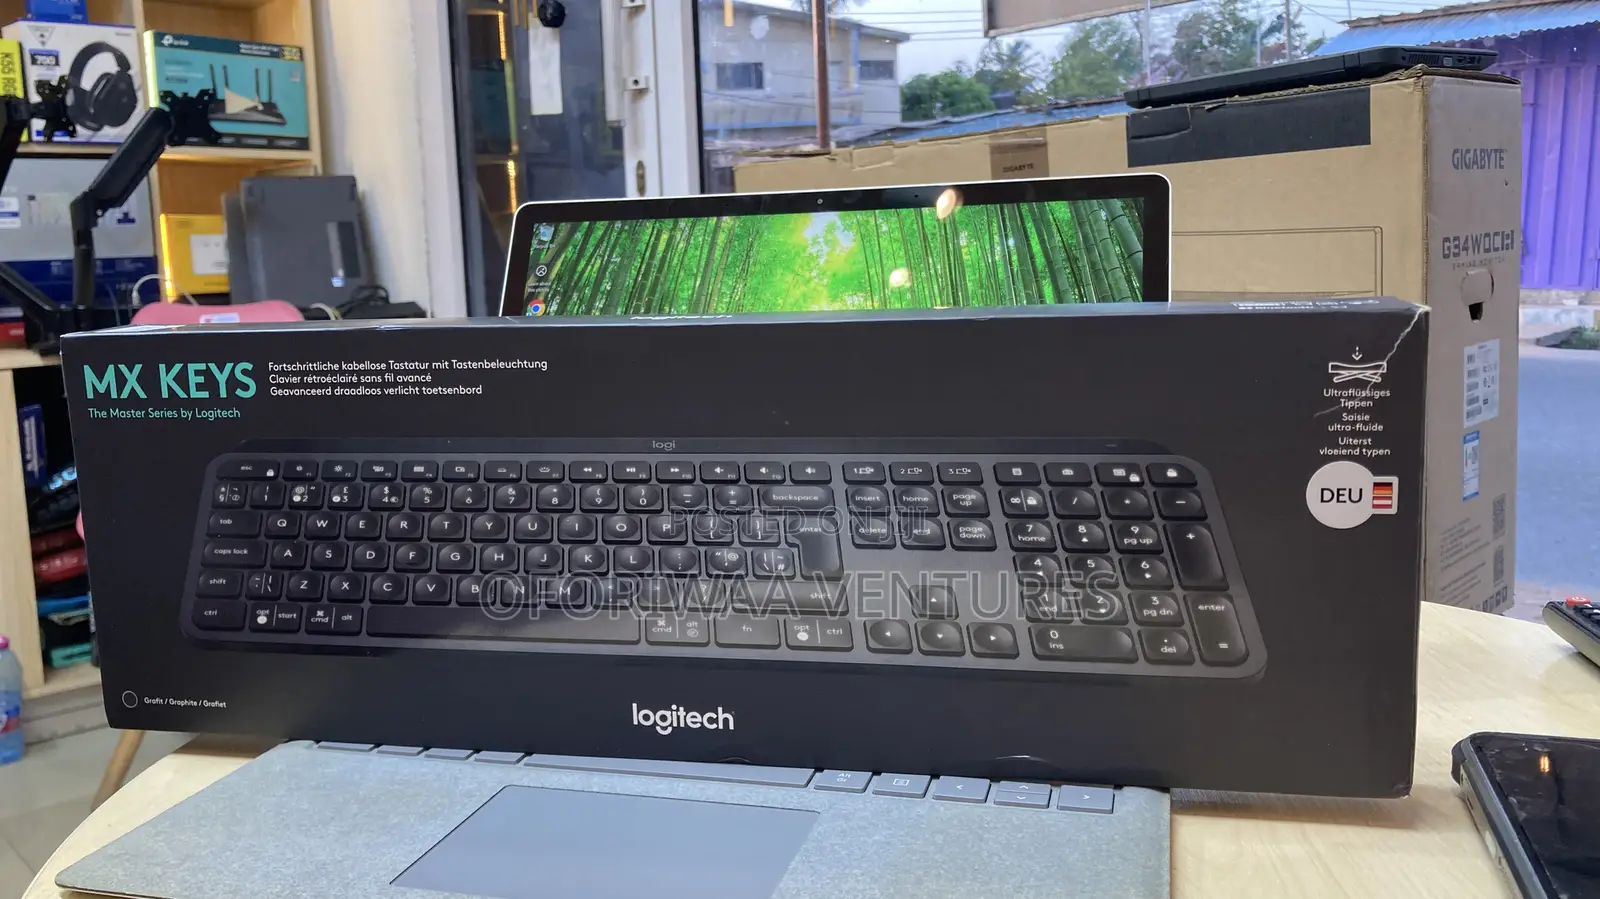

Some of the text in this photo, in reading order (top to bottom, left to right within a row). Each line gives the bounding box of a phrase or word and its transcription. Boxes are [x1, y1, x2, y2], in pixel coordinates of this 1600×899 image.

[1452, 148, 1505, 170] GIGABYTE
[1002, 163, 1034, 173] GIGABYTE
[268, 359, 548, 371] Fortschrittliche kabellose Tastatur mit Tastenbeleuchtung
[83, 361, 257, 399] MX KEYS
[269, 372, 432, 384] Clavier rétroéclairé sans fil avancé
[270, 385, 483, 396] Geavanceerd draadloos verlicht toetsenbord
[1323, 388, 1391, 399] Ultraflüssiges
[1340, 399, 1373, 409] Tippen
[88, 407, 241, 421] The Master Series by Logitech
[1342, 412, 1370, 421] Saisie
[1328, 422, 1384, 432] ultra-fluide
[1338, 436, 1372, 445] Uiterst
[652, 440, 676, 451] logi
[1319, 447, 1391, 458] vloeiend typen
[342, 495, 348, 503] 3
[772, 494, 819, 502] backspace
[855, 494, 881, 502] insert
[1320, 488, 1363, 503] DEU
[552, 497, 559, 505] 8
[277, 519, 288, 528] Q
[316, 520, 328, 528] W
[359, 520, 366, 529] E
[400, 521, 408, 529] R
[485, 522, 493, 530] Y
[528, 522, 538, 531] U
[616, 523, 627, 531] O
[663, 524, 671, 532] P
[1025, 524, 1033, 532] 7
[1078, 525, 1087, 533] 8
[1130, 526, 1139, 534] 9
[1018, 534, 1046, 542] home
[1123, 538, 1138, 546] pg
[233, 547, 248, 555] lock
[283, 549, 292, 557] A
[325, 550, 332, 558] S
[366, 551, 376, 559] D
[409, 552, 416, 560] F
[450, 552, 461, 561] G
[494, 553, 504, 562] H
[541, 554, 547, 563] J
[584, 554, 593, 563] K
[630, 555, 637, 564] L
[1033, 559, 1043, 567] 4
[1087, 559, 1095, 568] 5
[1140, 560, 1150, 569] 6
[209, 577, 226, 585] shift
[300, 581, 308, 589] Z
[341, 582, 350, 590] X
[383, 583, 393, 592] C
[426, 584, 436, 592] V
[471, 584, 480, 593] B
[559, 587, 570, 595] M
[1151, 596, 1160, 605] 3
[278, 611, 297, 619] start
[1143, 607, 1173, 617] pg dn
[686, 620, 698, 628] alt
[794, 624, 810, 632] opt
[827, 627, 843, 635] ctrl
[1049, 642, 1064, 650] ins
[1160, 645, 1177, 653] del
[144, 697, 164, 705] Grafit
[168, 698, 198, 707] Graphite
[202, 700, 227, 708] Grafiet
[632, 702, 735, 735] logitech
